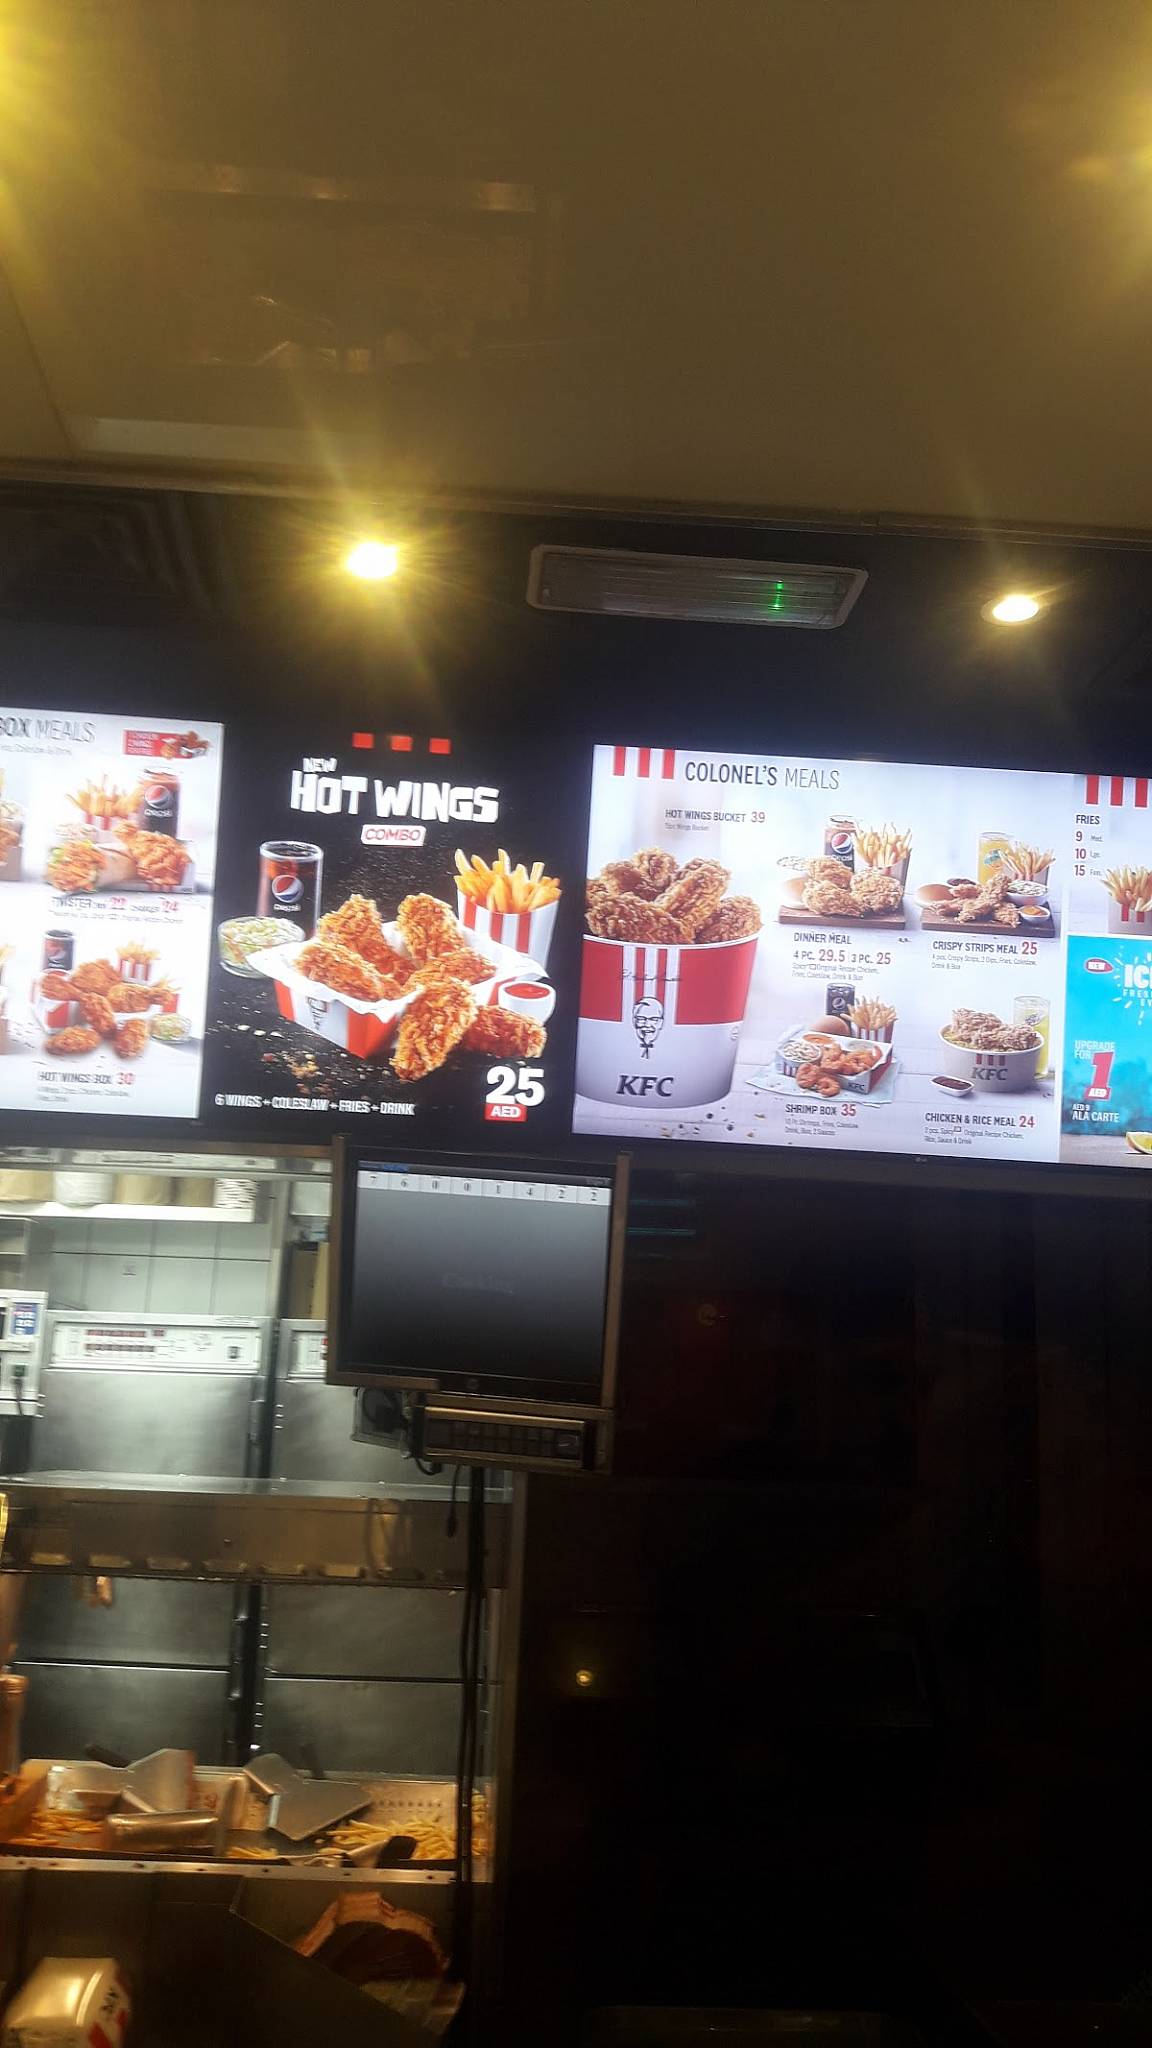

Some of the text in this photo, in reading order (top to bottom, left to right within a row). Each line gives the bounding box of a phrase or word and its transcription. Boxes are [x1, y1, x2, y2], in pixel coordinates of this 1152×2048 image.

[36, 719, 96, 743] MEALS
[303, 757, 337, 773] NEW
[685, 761, 840, 790] COLONEL'S MEALS
[290, 769, 499, 824] HOT WINGS
[665, 809, 766, 823] HOT WINGS BUCKET 39
[1075, 814, 1100, 825] FRIES
[363, 828, 422, 843] COMBO
[1076, 830, 1083, 842] 9
[1075, 848, 1086, 859] 10
[1074, 864, 1086, 876] 15
[793, 932, 852, 945] DINNER MEAL
[932, 941, 1038, 955] CRISPY STRIPS MEAL 25
[793, 950, 799, 959] 4
[818, 948, 845, 962] 29.5
[851, 953, 857, 963] 3
[876, 952, 891, 965] 25
[1124, 963, 1152, 989] IC
[1074, 1040, 1116, 1052] UPGRADE
[1074, 1050, 1092, 1060] FOR
[39, 1071, 58, 1081] HOT
[971, 1066, 1008, 1080] KFC
[484, 1066, 546, 1107] 25
[616, 1074, 674, 1097] KFC
[215, 1093, 224, 1106] 6
[225, 1094, 262, 1108] WINGS
[271, 1096, 329, 1111] COLESLAW
[338, 1099, 370, 1114] FRIES
[379, 1102, 415, 1116] DRINK
[785, 1103, 856, 1117] SHRIMP BOX 35
[491, 1106, 522, 1119] AED
[1072, 1110, 1120, 1123] ALA CARTE
[925, 1112, 1036, 1128] CHICKEN & RICE MEAL 24
